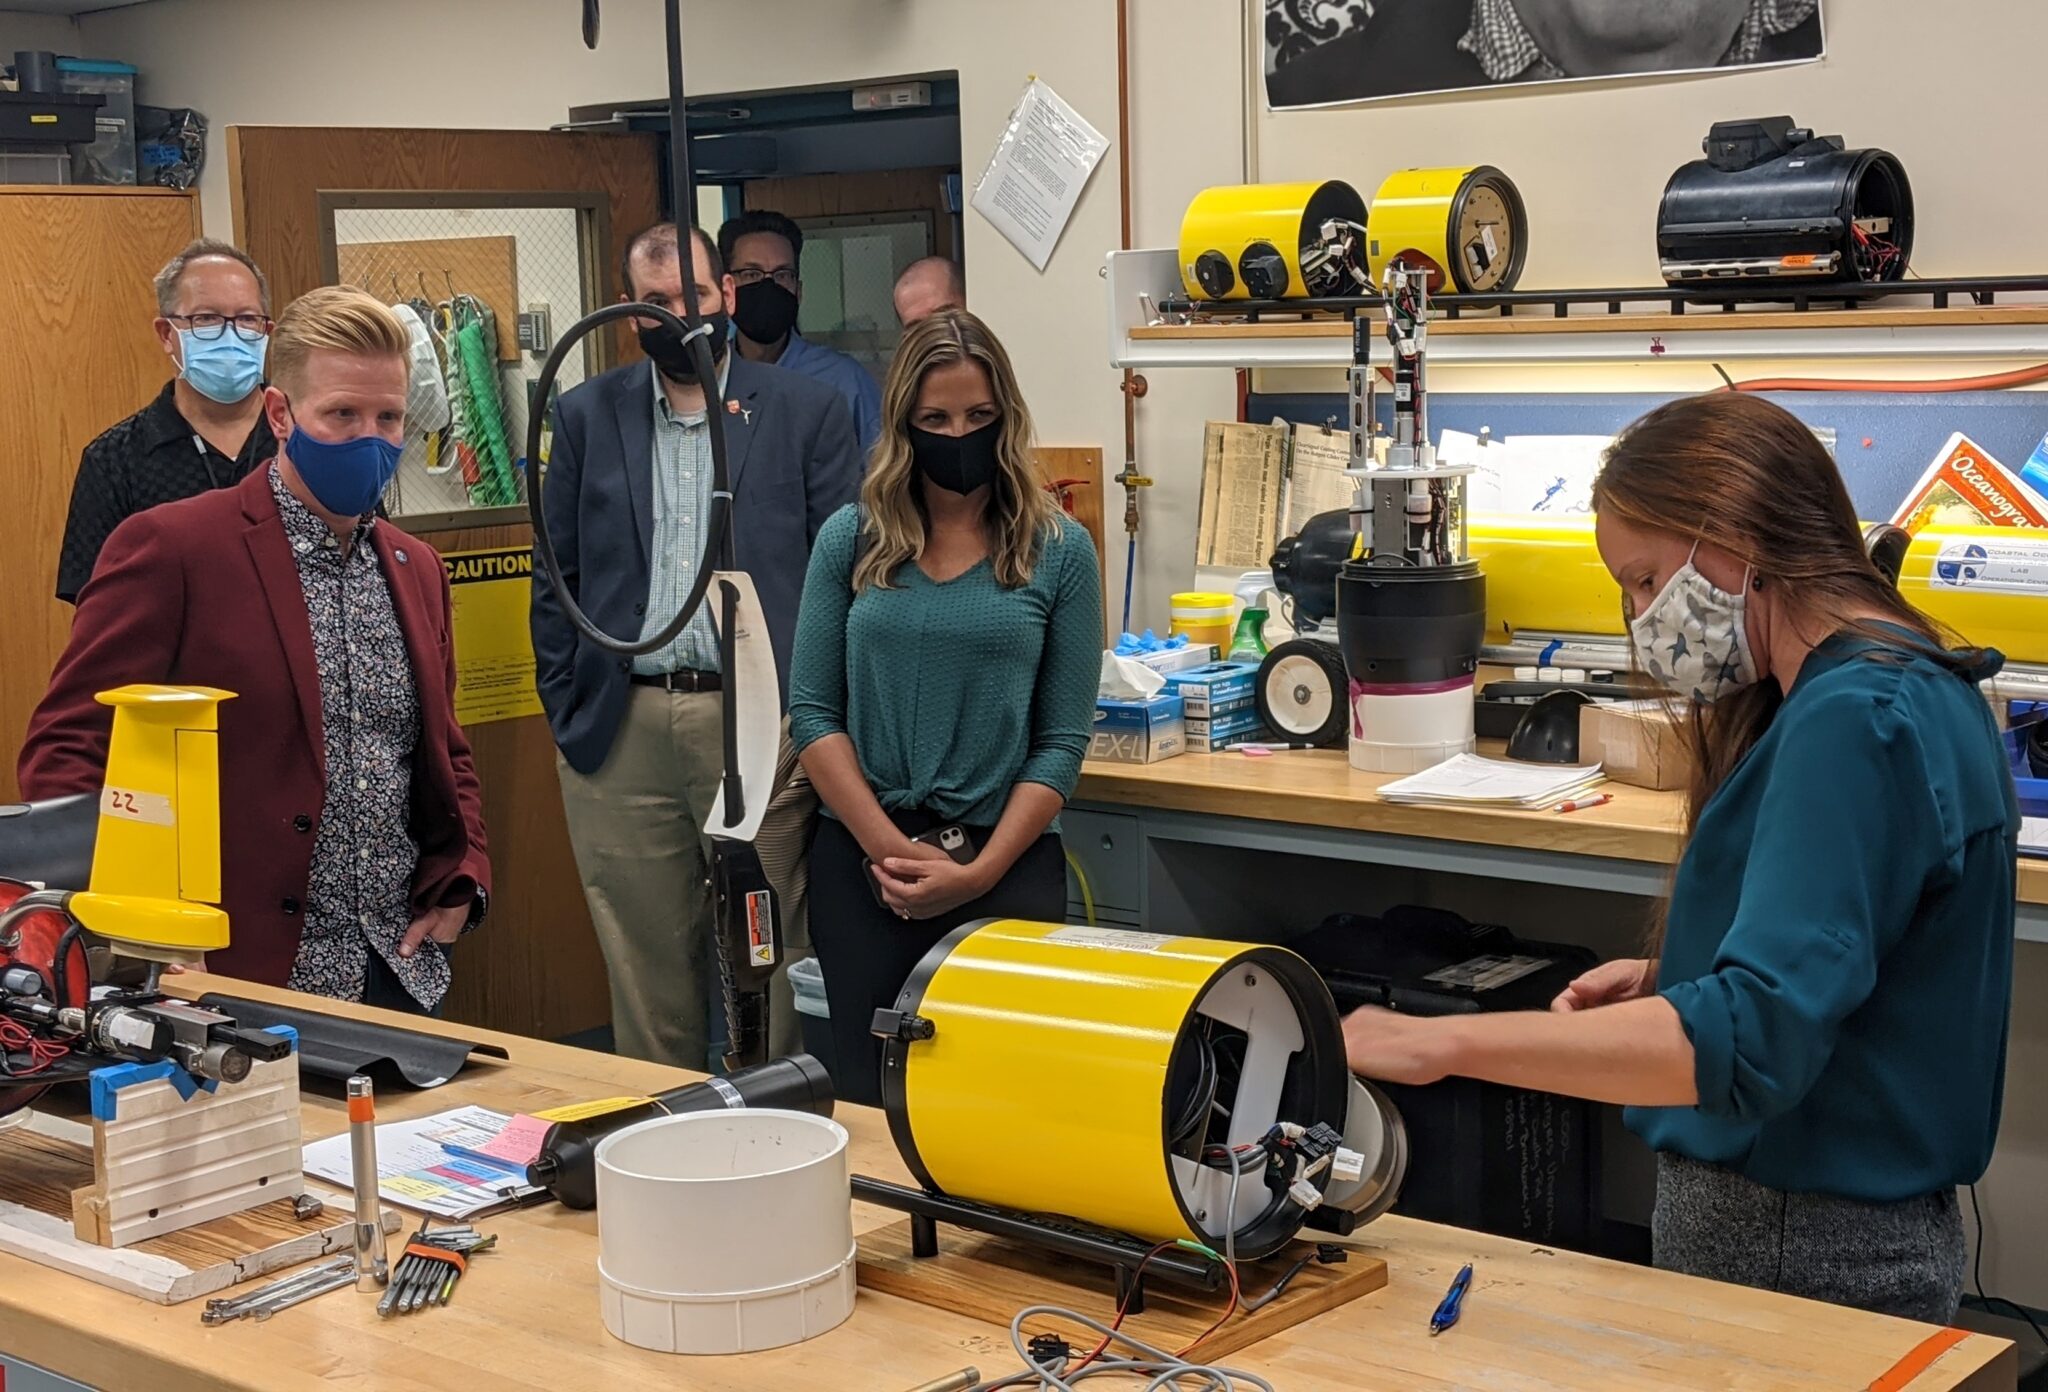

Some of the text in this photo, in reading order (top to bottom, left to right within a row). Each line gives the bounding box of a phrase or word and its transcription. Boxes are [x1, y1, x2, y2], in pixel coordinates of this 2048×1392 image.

[1951, 456, 2044, 528] Oceanogra
[444, 554, 532, 580] CAUTION
[112, 790, 139, 813] 22
